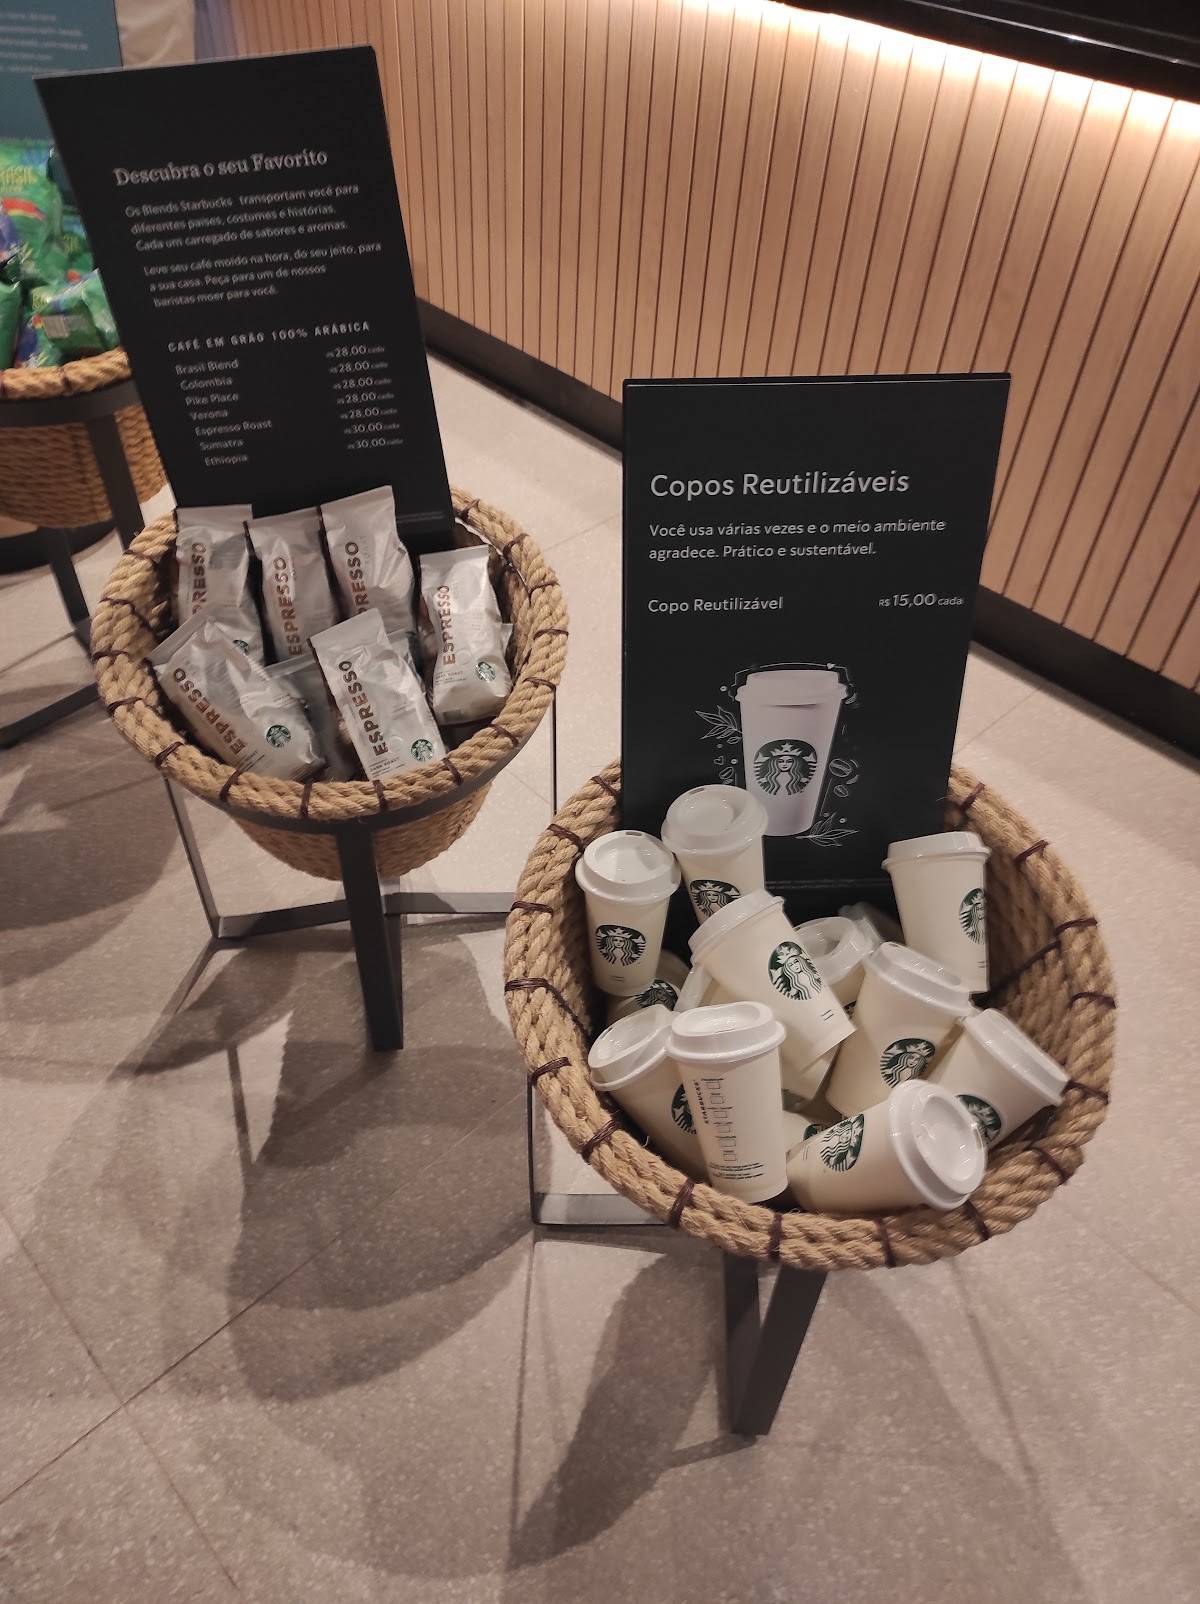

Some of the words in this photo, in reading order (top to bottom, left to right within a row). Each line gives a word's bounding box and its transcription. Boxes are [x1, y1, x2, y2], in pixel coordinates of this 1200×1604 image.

[113, 161, 200, 186] Descubra
[203, 162, 214, 176] o
[217, 159, 248, 175] seu
[250, 149, 328, 172] Favorito
[125, 205, 141, 218] Os
[142, 201, 179, 216] Blends
[180, 197, 233, 212] Starbucks
[239, 189, 306, 206] transportam
[308, 185, 333, 199] você
[335, 184, 359, 198] para
[131, 219, 186, 235] diferentes
[226, 210, 277, 224] costumes
[279, 209, 286, 219] e
[136, 238, 164, 252] Cada
[165, 237, 183, 249] um
[184, 230, 238, 246] carregado
[240, 228, 254, 241] de
[255, 224, 296, 239] sabores
[298, 223, 305, 234] e
[143, 262, 168, 277] Leve
[169, 262, 188, 274] seu
[190, 257, 212, 272] café
[250, 254, 263, 265] na
[294, 247, 308, 260] do
[310, 247, 328, 258] seu
[358, 241, 382, 255] para
[150, 281, 157, 292] a
[157, 280, 177, 291] sua
[204, 273, 230, 286] Peça
[231, 270, 255, 285] para
[256, 269, 274, 281] um
[276, 265, 289, 278] de
[291, 263, 327, 277] nossos
[153, 294, 195, 308] baristas
[196, 291, 225, 303] moer
[226, 287, 250, 302] para
[168, 338, 200, 353] CAFÉ
[206, 337, 225, 349] EM
[230, 331, 265, 347] GRÃO
[271, 327, 309, 342] 100%
[175, 363, 206, 377] Brasil
[207, 357, 240, 373] Blend
[185, 396, 209, 407] Pike
[209, 392, 240, 403] Place
[190, 409, 229, 421] Verona
[194, 423, 241, 437] Espresso
[242, 419, 273, 432] Roast
[199, 439, 244, 452] Sumatra
[204, 454, 249, 467] Ethiopia
[650, 474, 734, 501] Copos
[743, 470, 910, 495] Reutilizáveis
[649, 523, 686, 537] Você
[689, 525, 713, 536] usa
[717, 522, 761, 536] várias
[764, 523, 804, 535] vezes
[807, 523, 817, 534] e
[820, 524, 830, 534] o
[832, 520, 871, 533] meio
[873, 518, 946, 533] ambiente
[649, 546, 719, 562] agradece.
[723, 545, 774, 559] Prático
[777, 548, 786, 557] e
[790, 542, 876, 557] sustentável.
[191, 543, 207, 615] PRESSO
[345, 542, 369, 614] RESSO
[273, 557, 303, 656] ESPRESSO
[648, 599, 689, 614] Copo
[694, 596, 784, 612] Reutilizável
[893, 593, 936, 608] 15,00
[938, 597, 962, 606] cada
[437, 585, 456, 665] ESPRESSO
[174, 667, 248, 755] ESPRESSO
[339, 661, 388, 756] ESPRESSO
